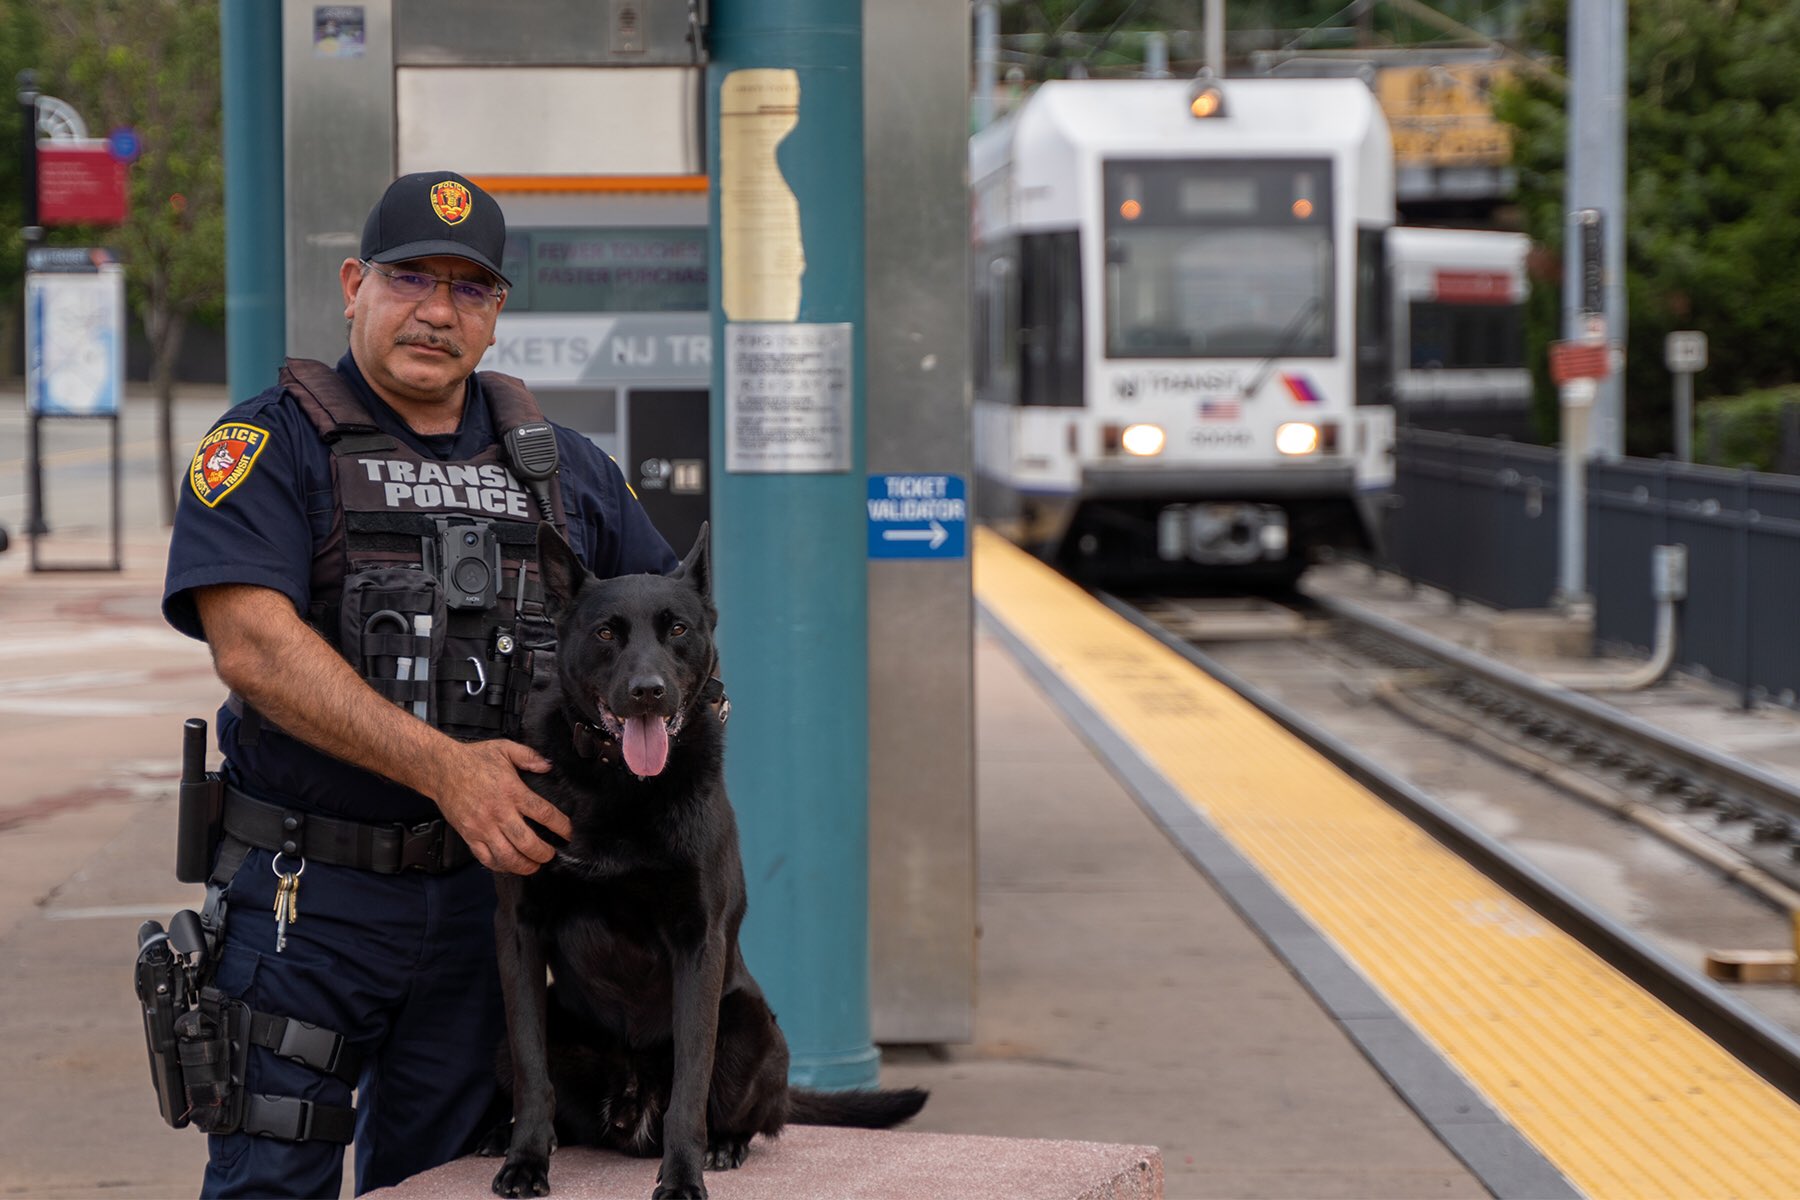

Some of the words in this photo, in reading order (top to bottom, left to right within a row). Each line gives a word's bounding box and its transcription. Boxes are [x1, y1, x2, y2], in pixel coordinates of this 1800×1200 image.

[538, 241, 603, 260] FEWER
[538, 267, 609, 285] FASTER
[615, 266, 709, 285] PURCHAS
[483, 336, 590, 367] KETS
[611, 335, 656, 367] NJ
[667, 335, 711, 366] TR
[203, 428, 259, 449] POLICE
[222, 454, 251, 487] TRANSIT
[358, 459, 531, 493] TRANSI
[384, 482, 529, 518] POLICE
[884, 476, 949, 498] TICKET
[867, 498, 965, 522] VALIDATOR
